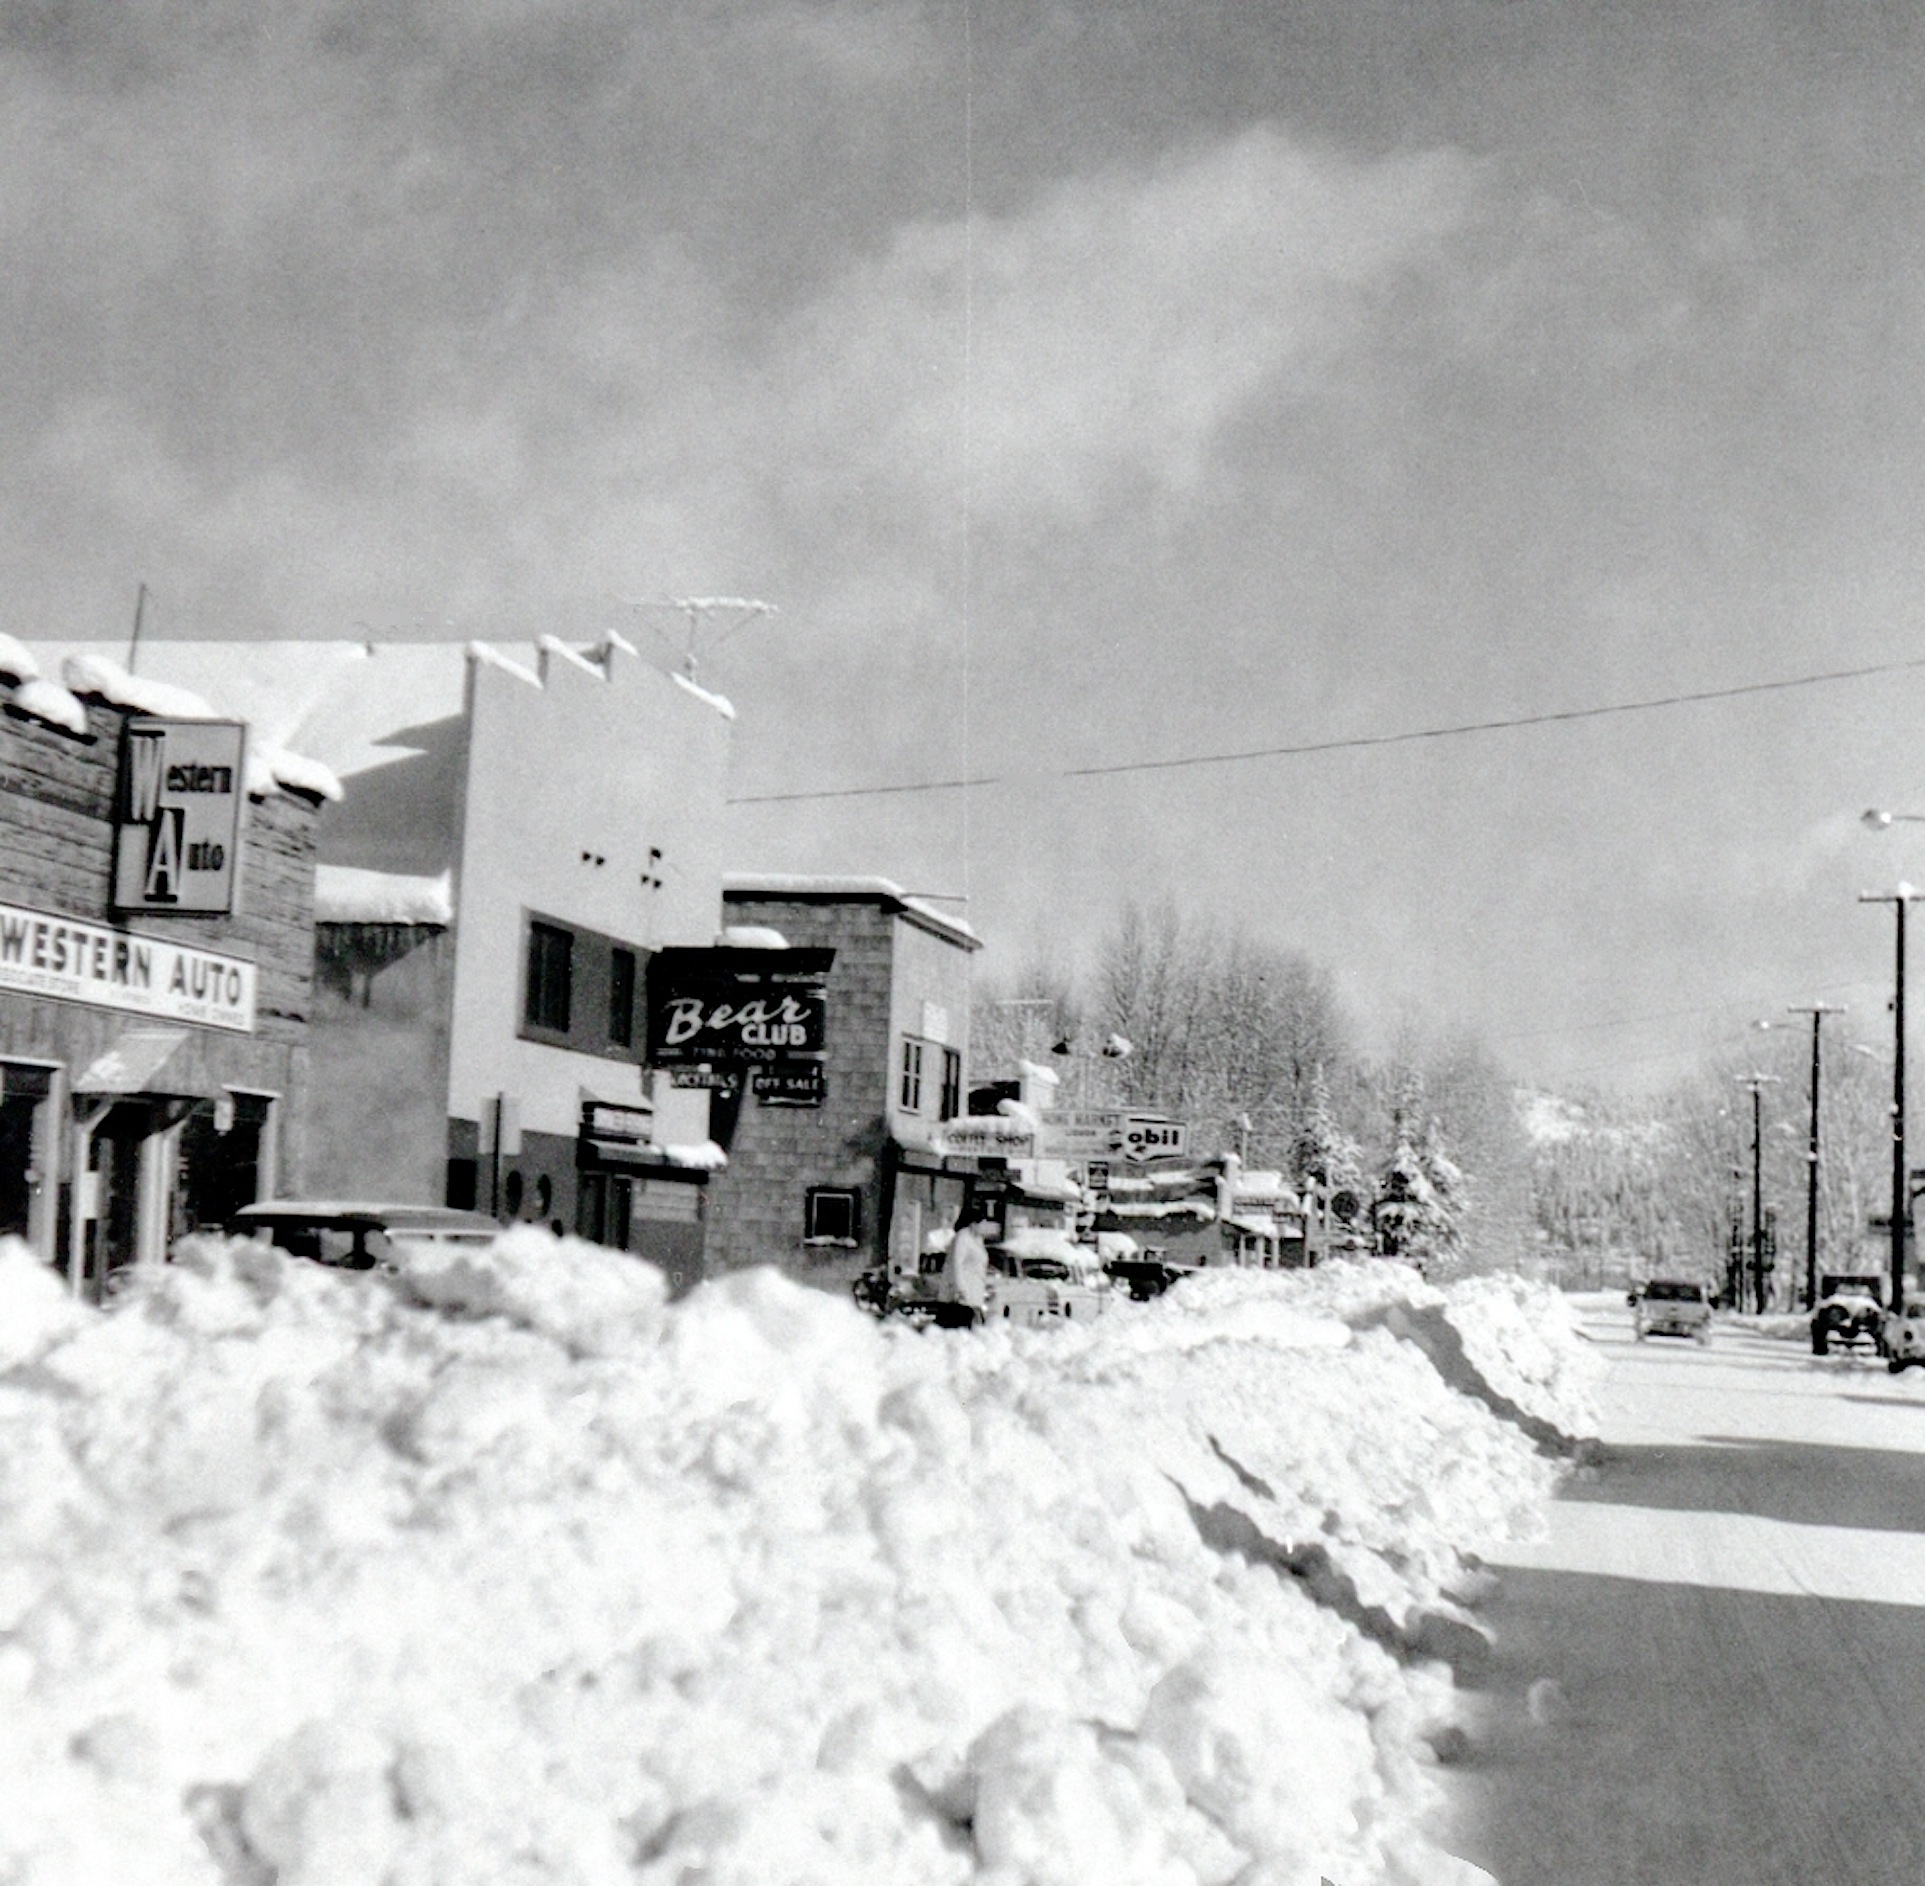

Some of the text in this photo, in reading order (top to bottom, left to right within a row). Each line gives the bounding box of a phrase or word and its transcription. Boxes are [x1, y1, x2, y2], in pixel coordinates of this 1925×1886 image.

[129, 729, 232, 825] Western
[143, 805, 225, 904] Auto
[1, 912, 242, 1008] WESTERN AUTO
[661, 996, 812, 1045] Bear
[741, 1022, 808, 1046] CLUB
[1127, 1128, 1180, 1146] obil
